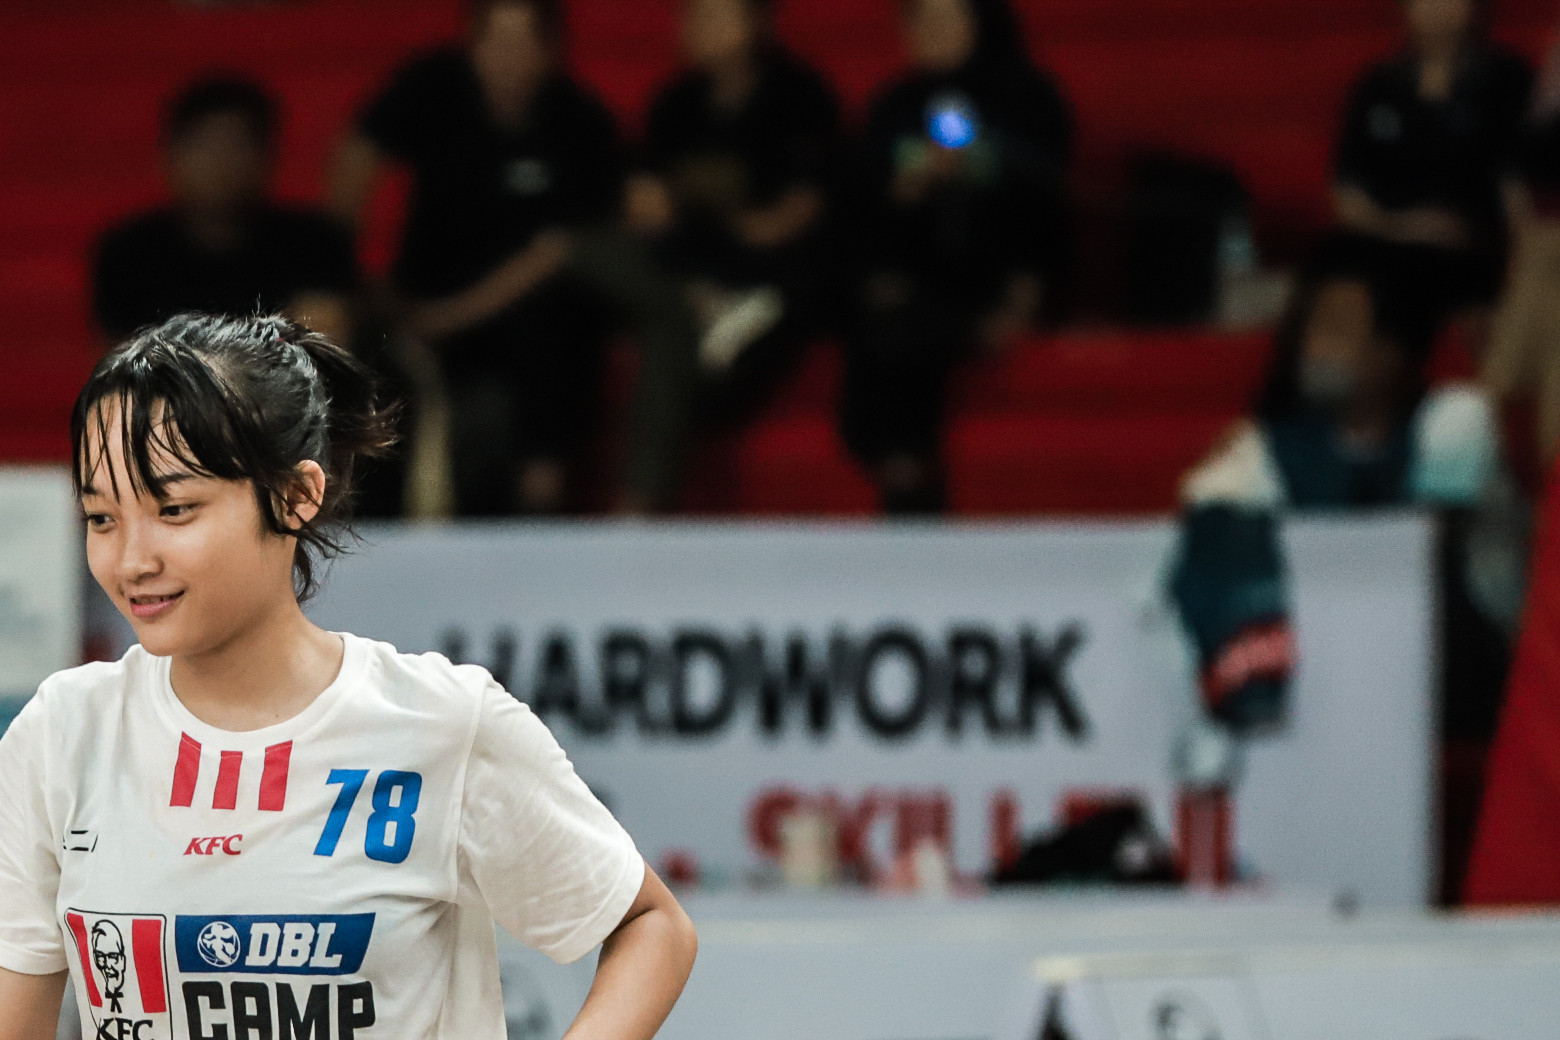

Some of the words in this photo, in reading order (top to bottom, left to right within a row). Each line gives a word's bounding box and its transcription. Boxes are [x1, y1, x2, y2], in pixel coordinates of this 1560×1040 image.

[313, 768, 423, 864] 78
[183, 834, 243, 856] KFC
[245, 922, 343, 968] DBL
